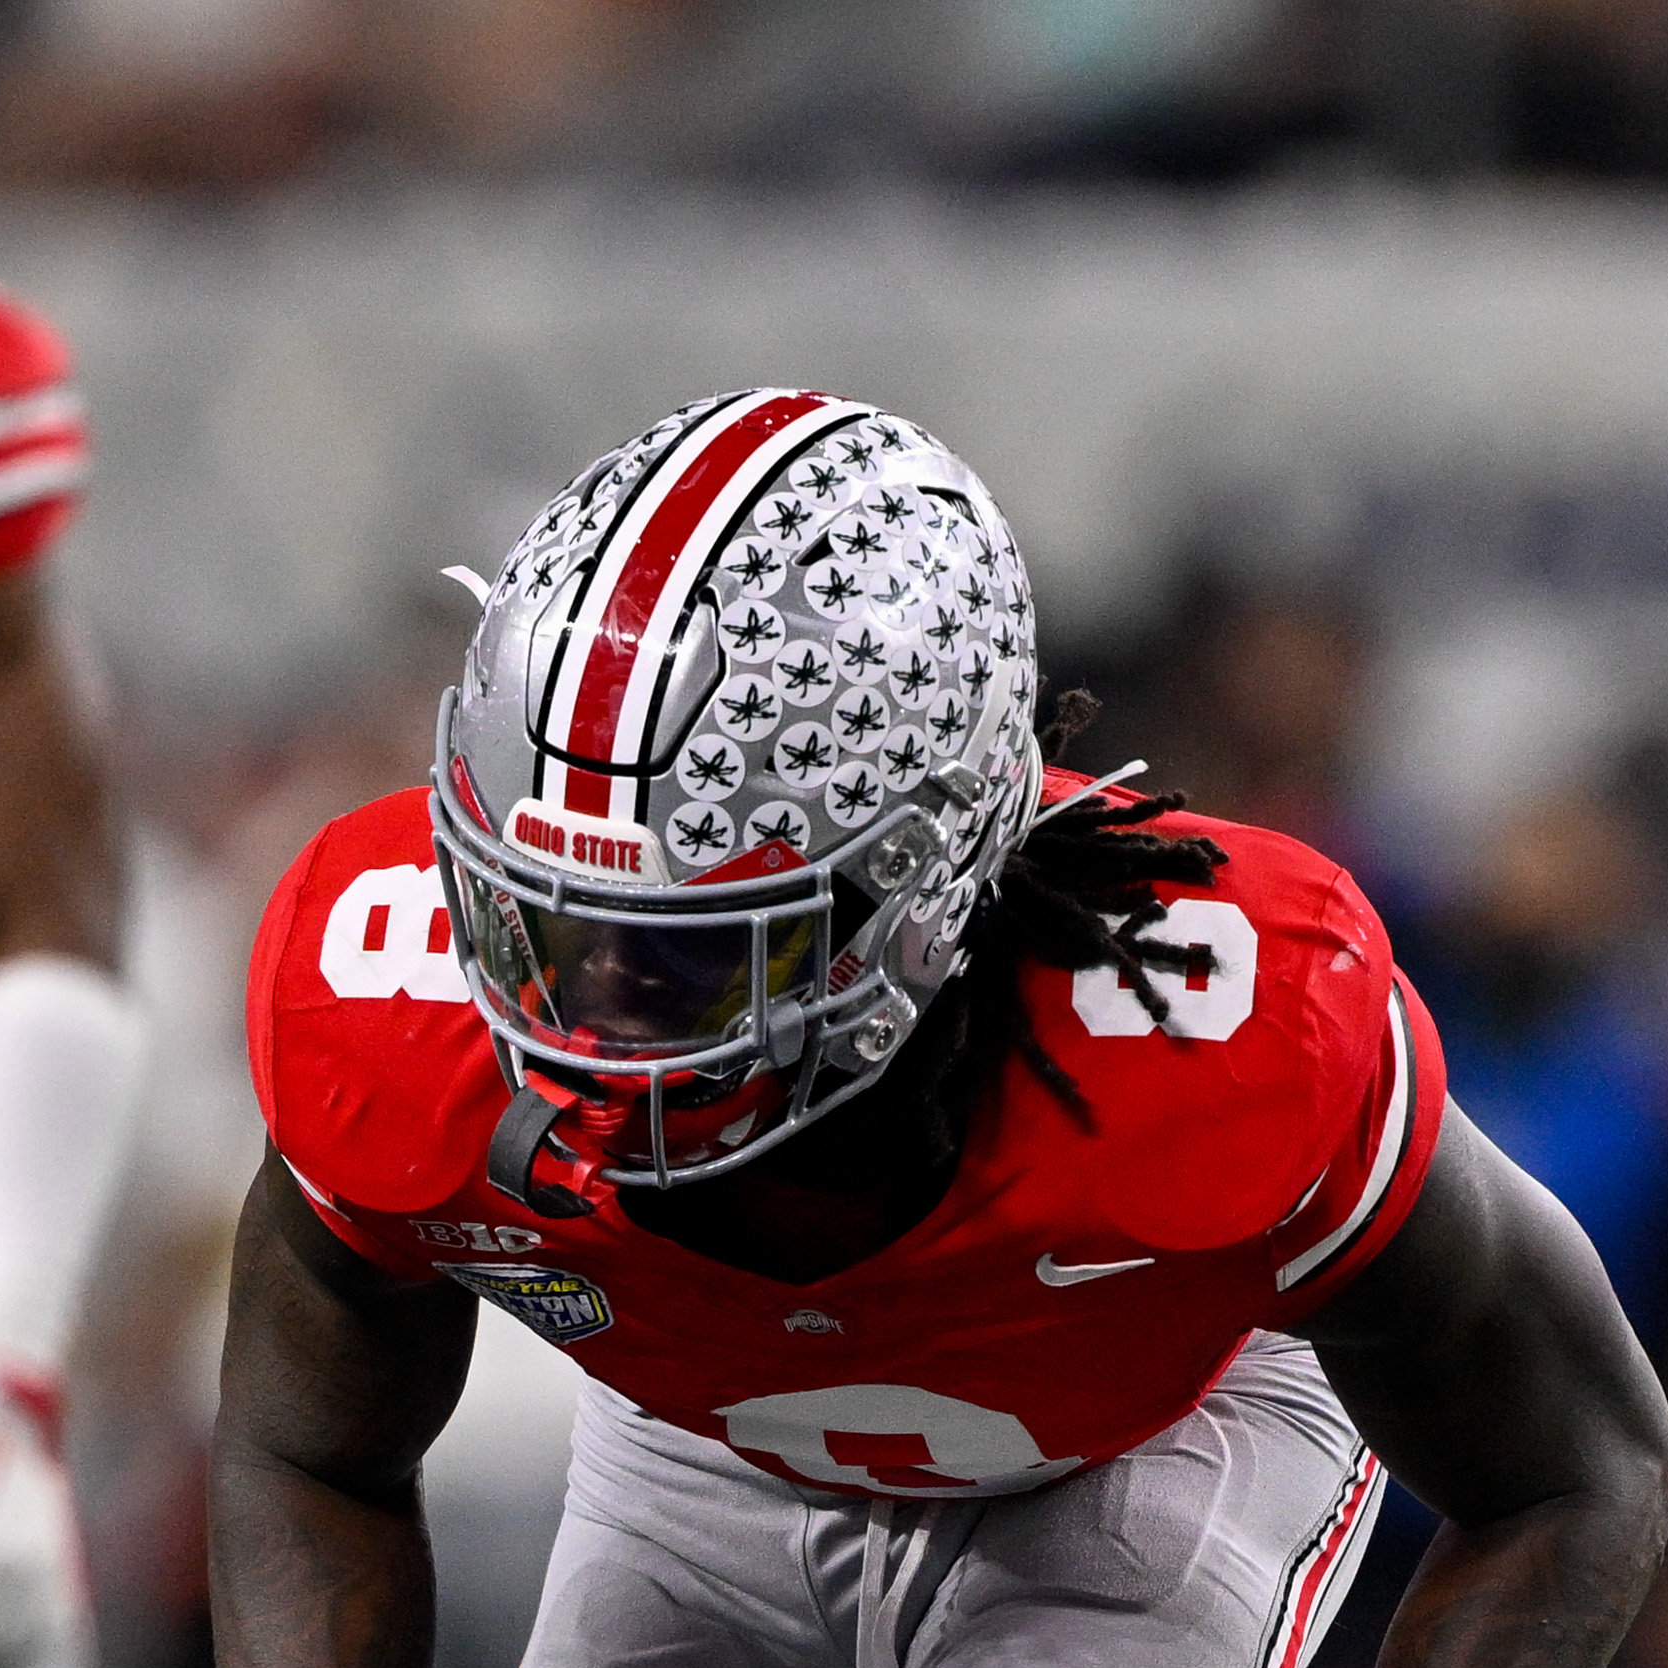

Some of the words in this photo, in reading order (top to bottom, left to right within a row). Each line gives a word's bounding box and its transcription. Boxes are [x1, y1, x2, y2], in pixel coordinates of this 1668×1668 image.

[515, 812, 565, 856] OHIO
[572, 832, 642, 873] STATE
[486, 856, 511, 905] OO
[319, 864, 472, 1003] 8
